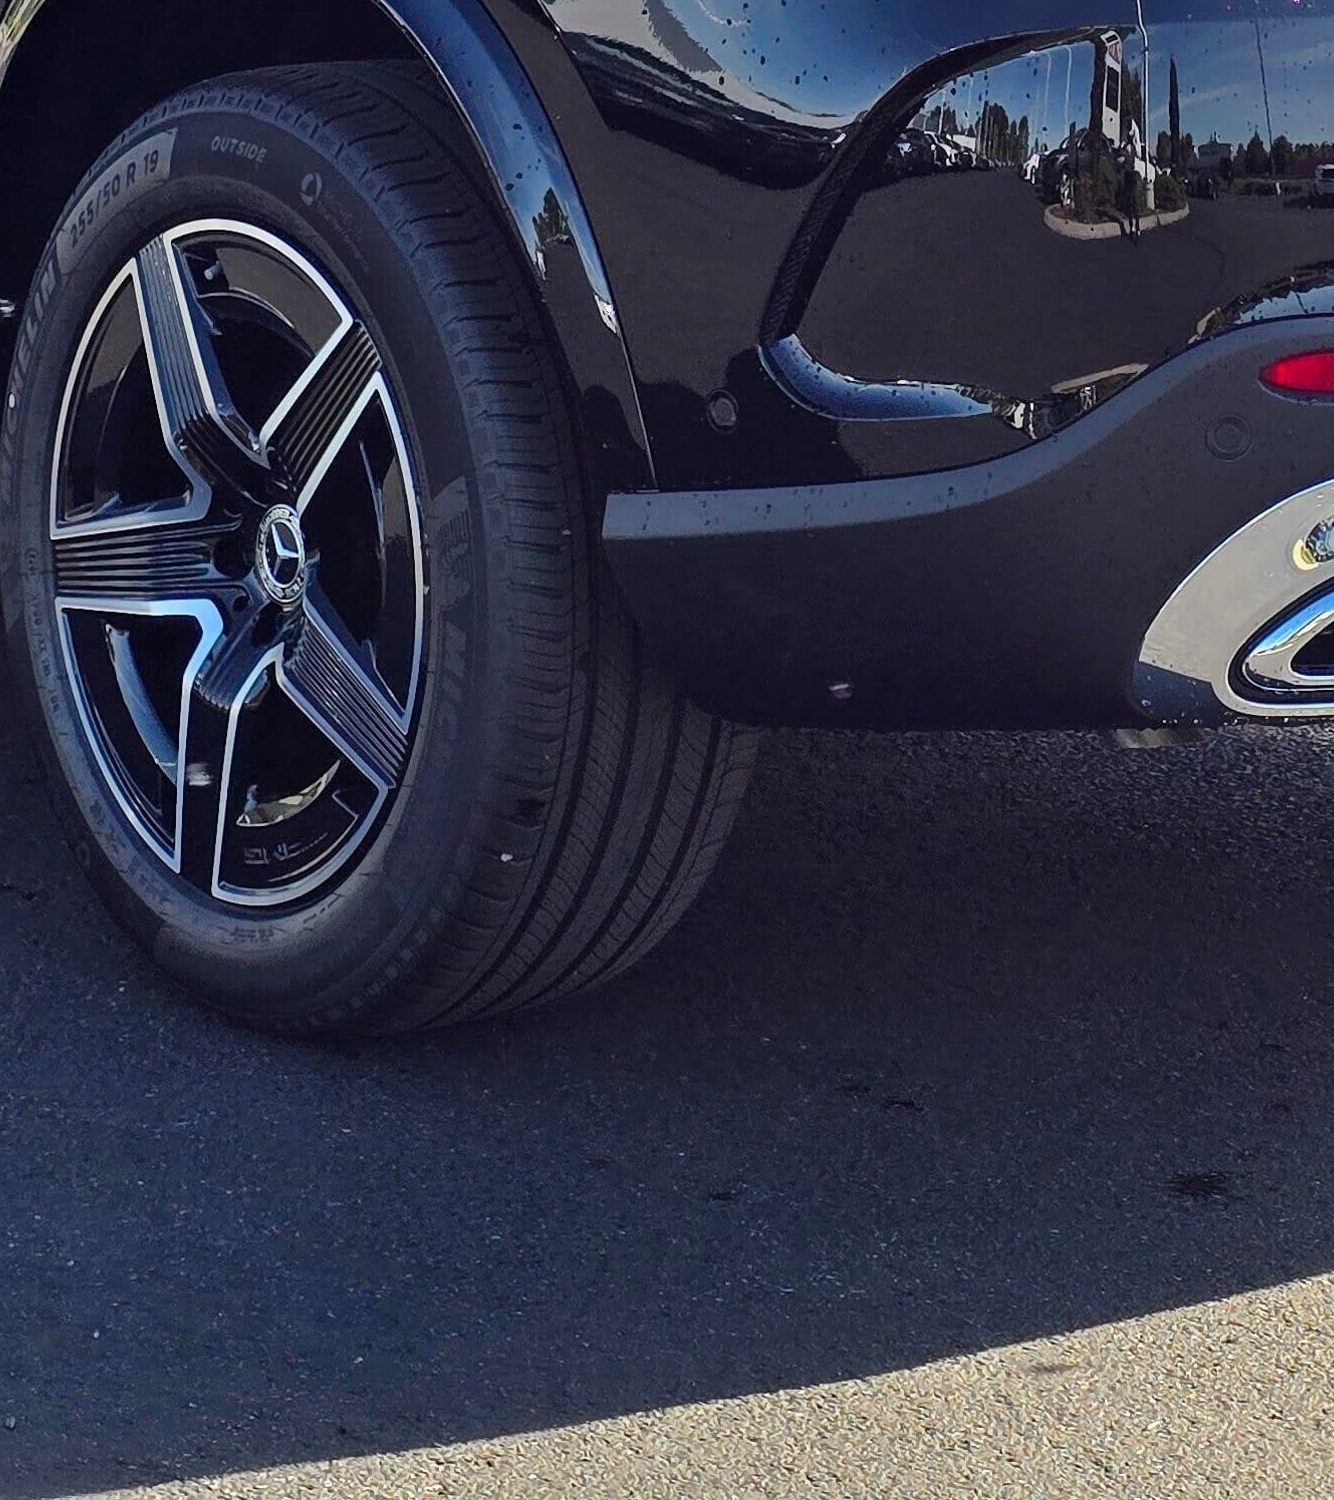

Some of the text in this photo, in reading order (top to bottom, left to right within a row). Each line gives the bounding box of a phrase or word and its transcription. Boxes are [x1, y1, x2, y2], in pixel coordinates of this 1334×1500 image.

[210, 135, 267, 163] OUTSIDE
[69, 150, 159, 248] 255/50 R 19
